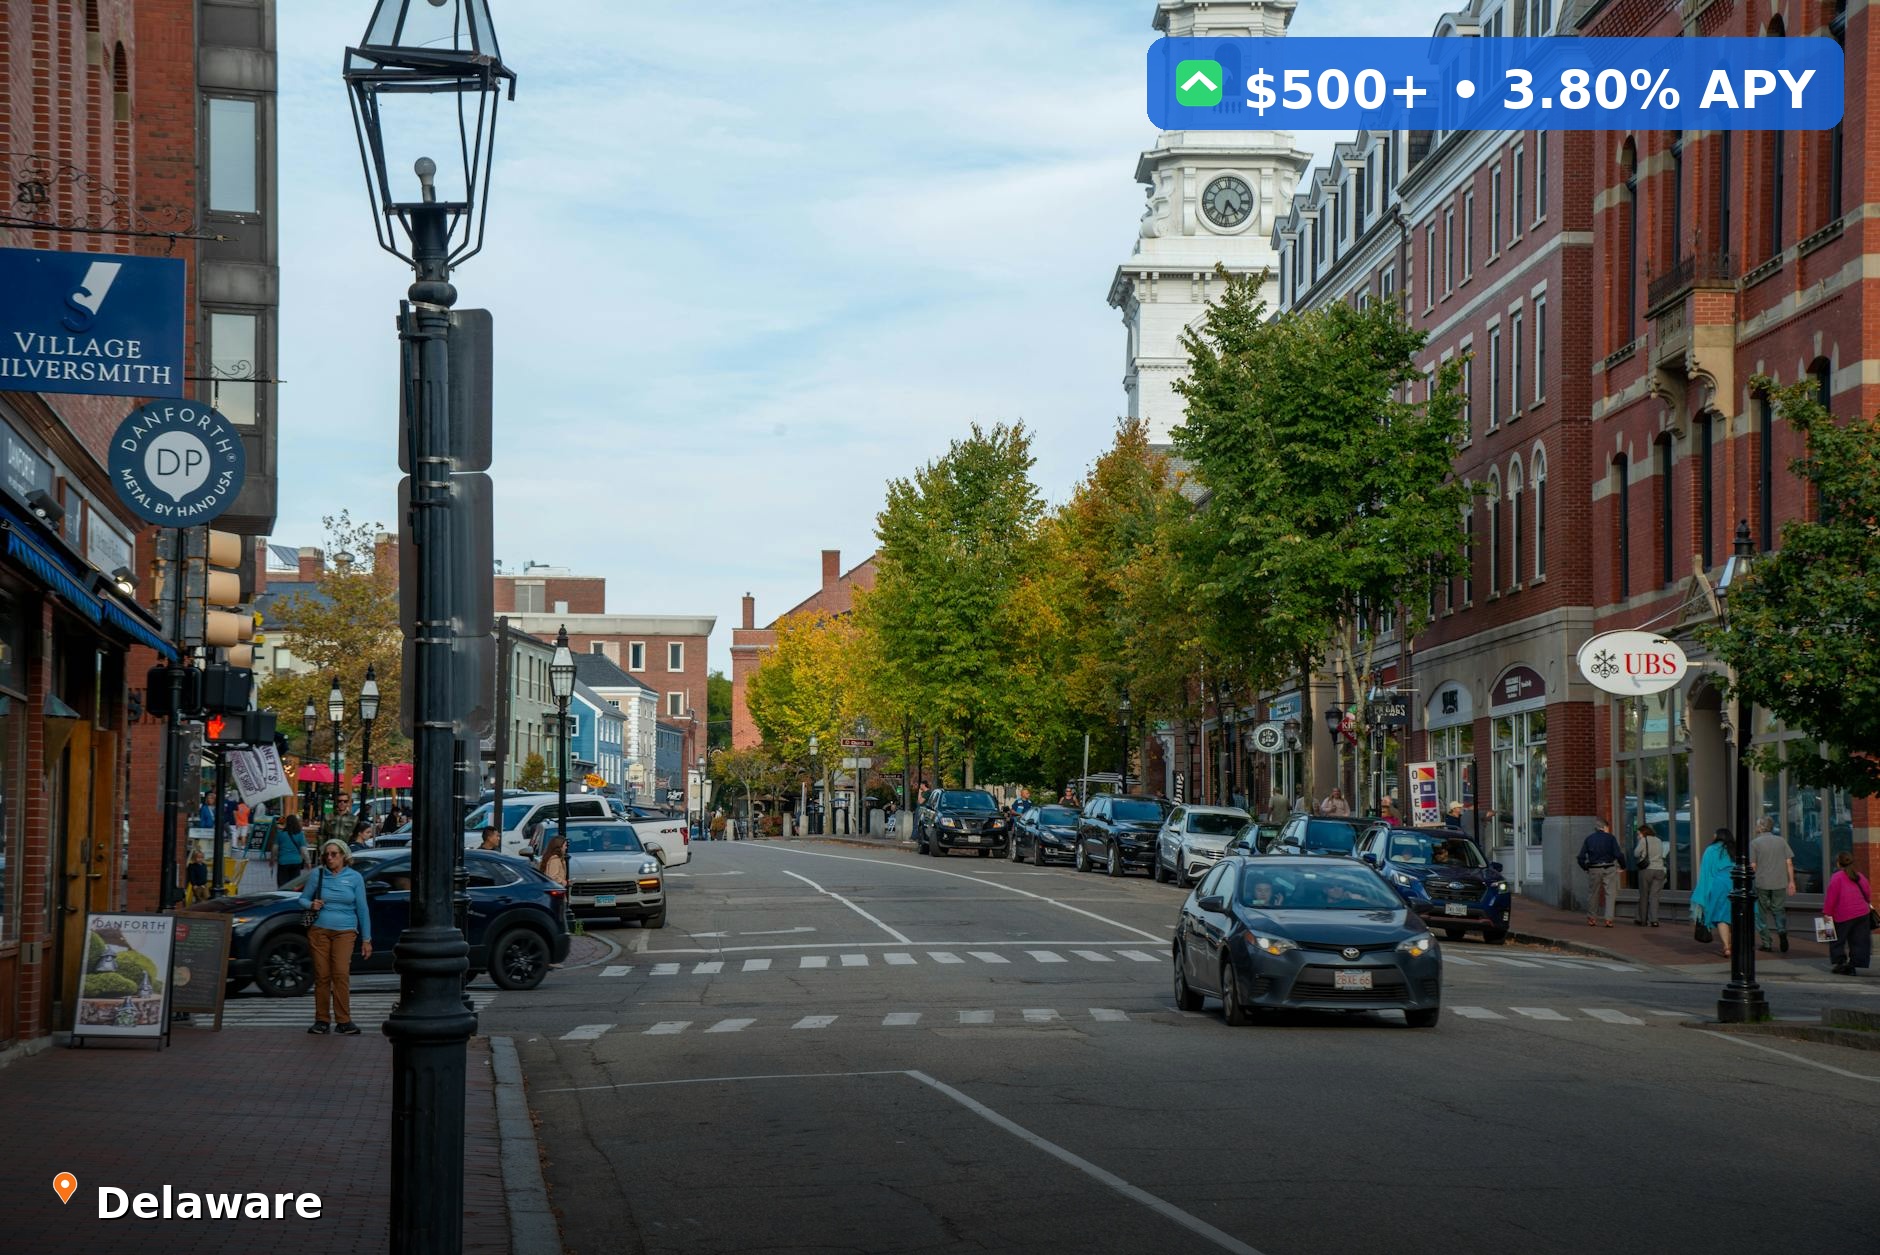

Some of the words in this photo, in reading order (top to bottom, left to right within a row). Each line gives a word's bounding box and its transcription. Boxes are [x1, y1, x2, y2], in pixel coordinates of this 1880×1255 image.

[13, 331, 142, 359] VILLAGE
[0, 357, 172, 386] ILVERSMITH
[157, 448, 203, 477] DP
[120, 468, 153, 508] METAL
[155, 502, 173, 517] BY
[177, 494, 217, 517] HAND
[213, 469, 235, 496] USA
[1624, 653, 1677, 675] UBS
[96, 920, 166, 930] DANFORTH
